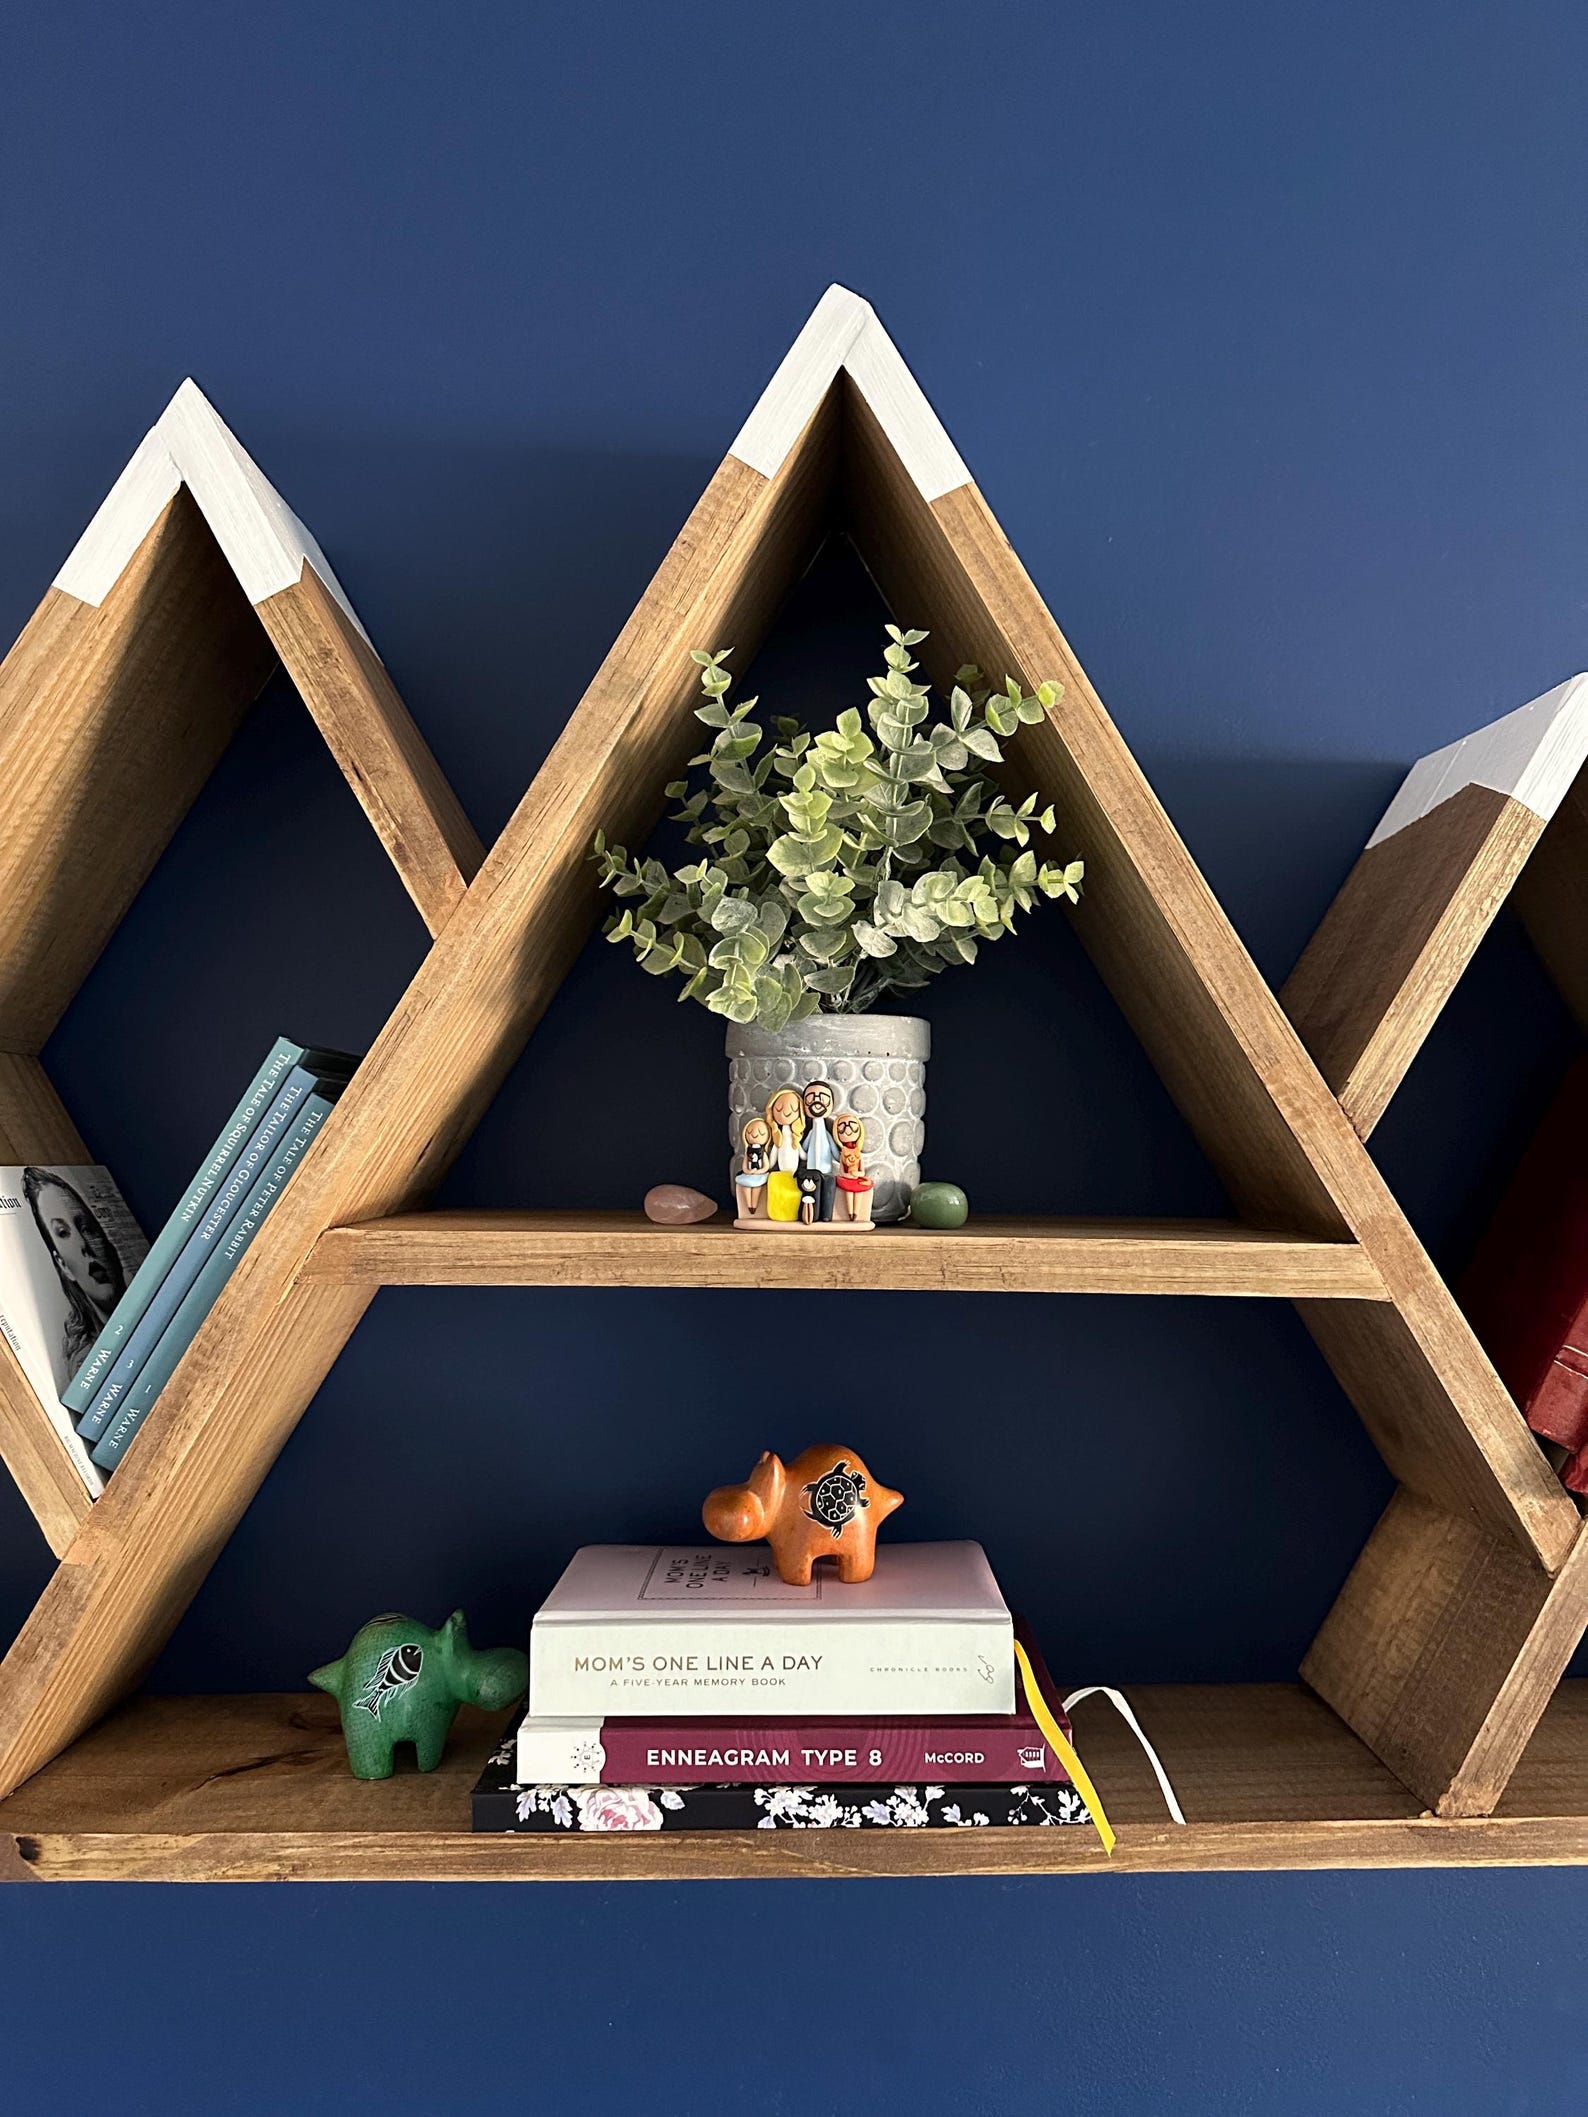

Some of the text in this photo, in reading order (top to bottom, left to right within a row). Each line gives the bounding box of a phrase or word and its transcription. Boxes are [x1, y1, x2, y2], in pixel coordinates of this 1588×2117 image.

[181, 1054, 291, 1222] THE TALE OF SQUIRREL NUTKIN
[200, 1086, 303, 1240] THE TAILOR OF GLOUCESTER
[225, 1111, 323, 1260] THE TALE OF PETER RABBIT
[115, 1325, 124, 1336] 2
[80, 1348, 112, 1390] WARNE
[127, 1359, 135, 1369] 3
[145, 1384, 152, 1393] 1
[92, 1383, 123, 1424] WARNE
[108, 1408, 140, 1449] WARNE
[664, 1559, 688, 1584] MOM'S
[686, 1554, 712, 1588] ONE LINE
[712, 1561, 731, 1575] DAY
[574, 1655, 823, 1672] MOM'S ONE LINE A DAY
[610, 1678, 787, 1687] A FIVE-YEAR MEMORY BOOK
[647, 1749, 883, 1766] ENNEAGRAM TYPE 8
[924, 1752, 985, 1764] McCORD
